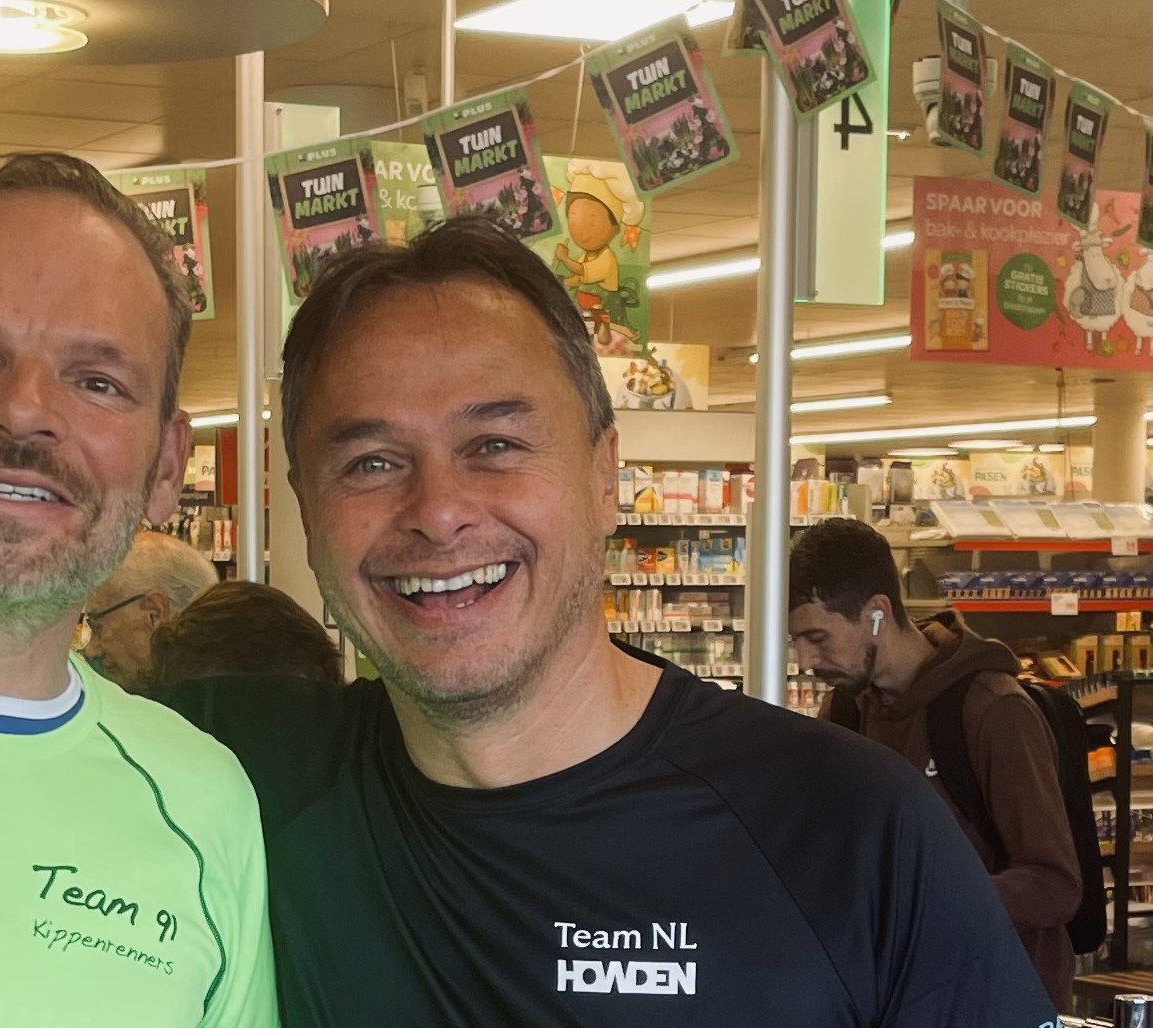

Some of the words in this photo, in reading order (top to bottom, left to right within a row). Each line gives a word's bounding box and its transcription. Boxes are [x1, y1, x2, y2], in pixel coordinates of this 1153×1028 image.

[626, 56, 670, 91] TUIN
[624, 69, 686, 114] MARKT
[463, 102, 492, 118] PLUS
[307, 148, 337, 161] PLUS
[459, 125, 502, 155] TUIN
[454, 140, 518, 177] MARKT
[141, 175, 171, 185] PLUS
[302, 172, 344, 198] TUIN
[295, 188, 358, 219] MARKT
[926, 193, 986, 214] SPAAR
[991, 199, 1043, 219] VOOR
[964, 222, 977, 239] &
[975, 471, 1006, 482] PASEN
[32, 864, 139, 926] Team
[156, 909, 177, 943] 91
[33, 919, 174, 975] Kippenrenners
[554, 921, 641, 949] Team
[652, 922, 698, 950] NL
[557, 959, 697, 995] HOWDEN
